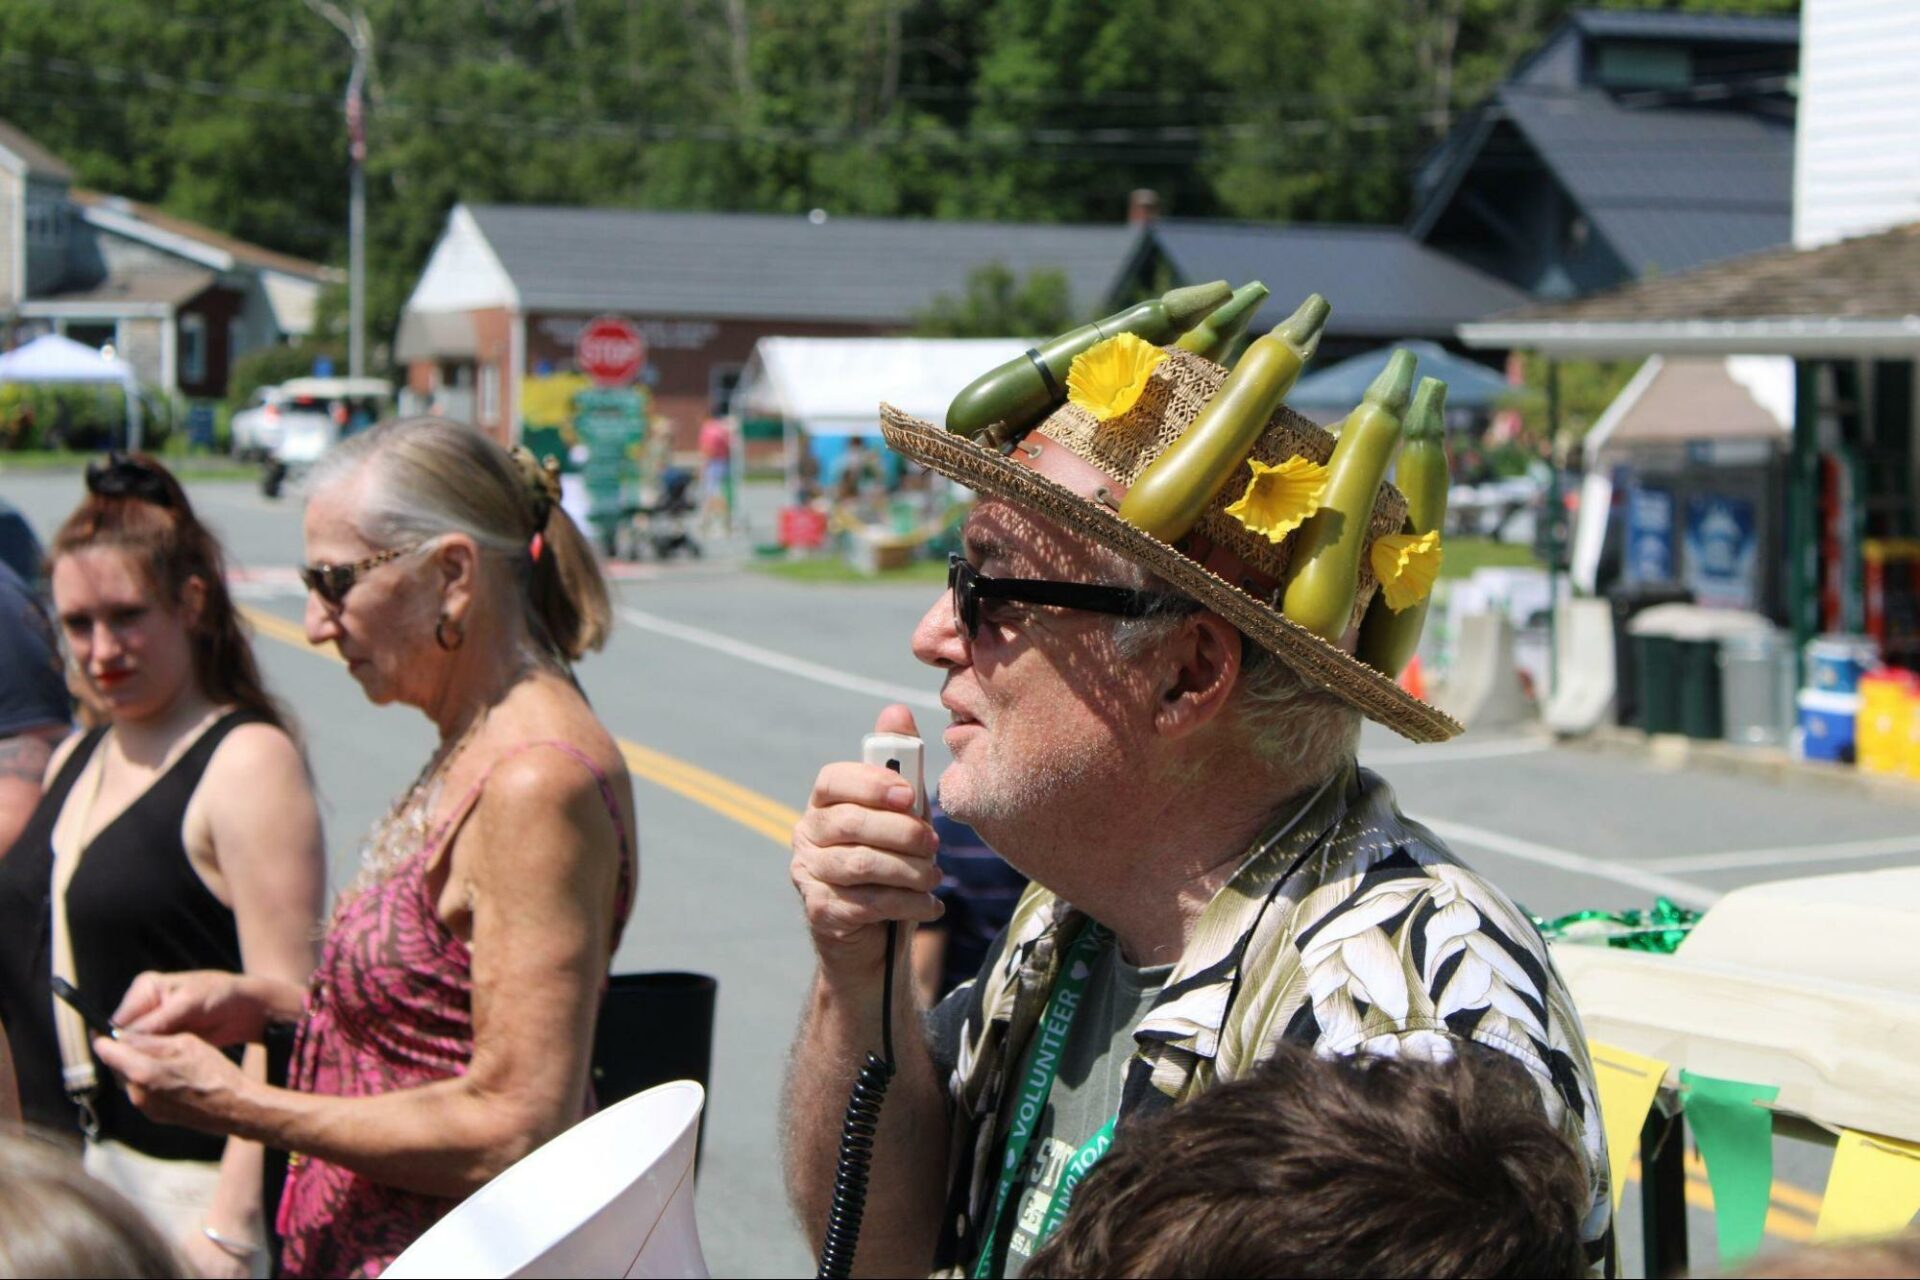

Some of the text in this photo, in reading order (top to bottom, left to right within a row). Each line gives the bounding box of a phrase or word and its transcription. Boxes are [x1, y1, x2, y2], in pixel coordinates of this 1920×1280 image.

[580, 338, 638, 365] STOP
[1012, 988, 1080, 1137] VOLUNTEER
[1043, 1135, 1110, 1236] VOLUNTE
